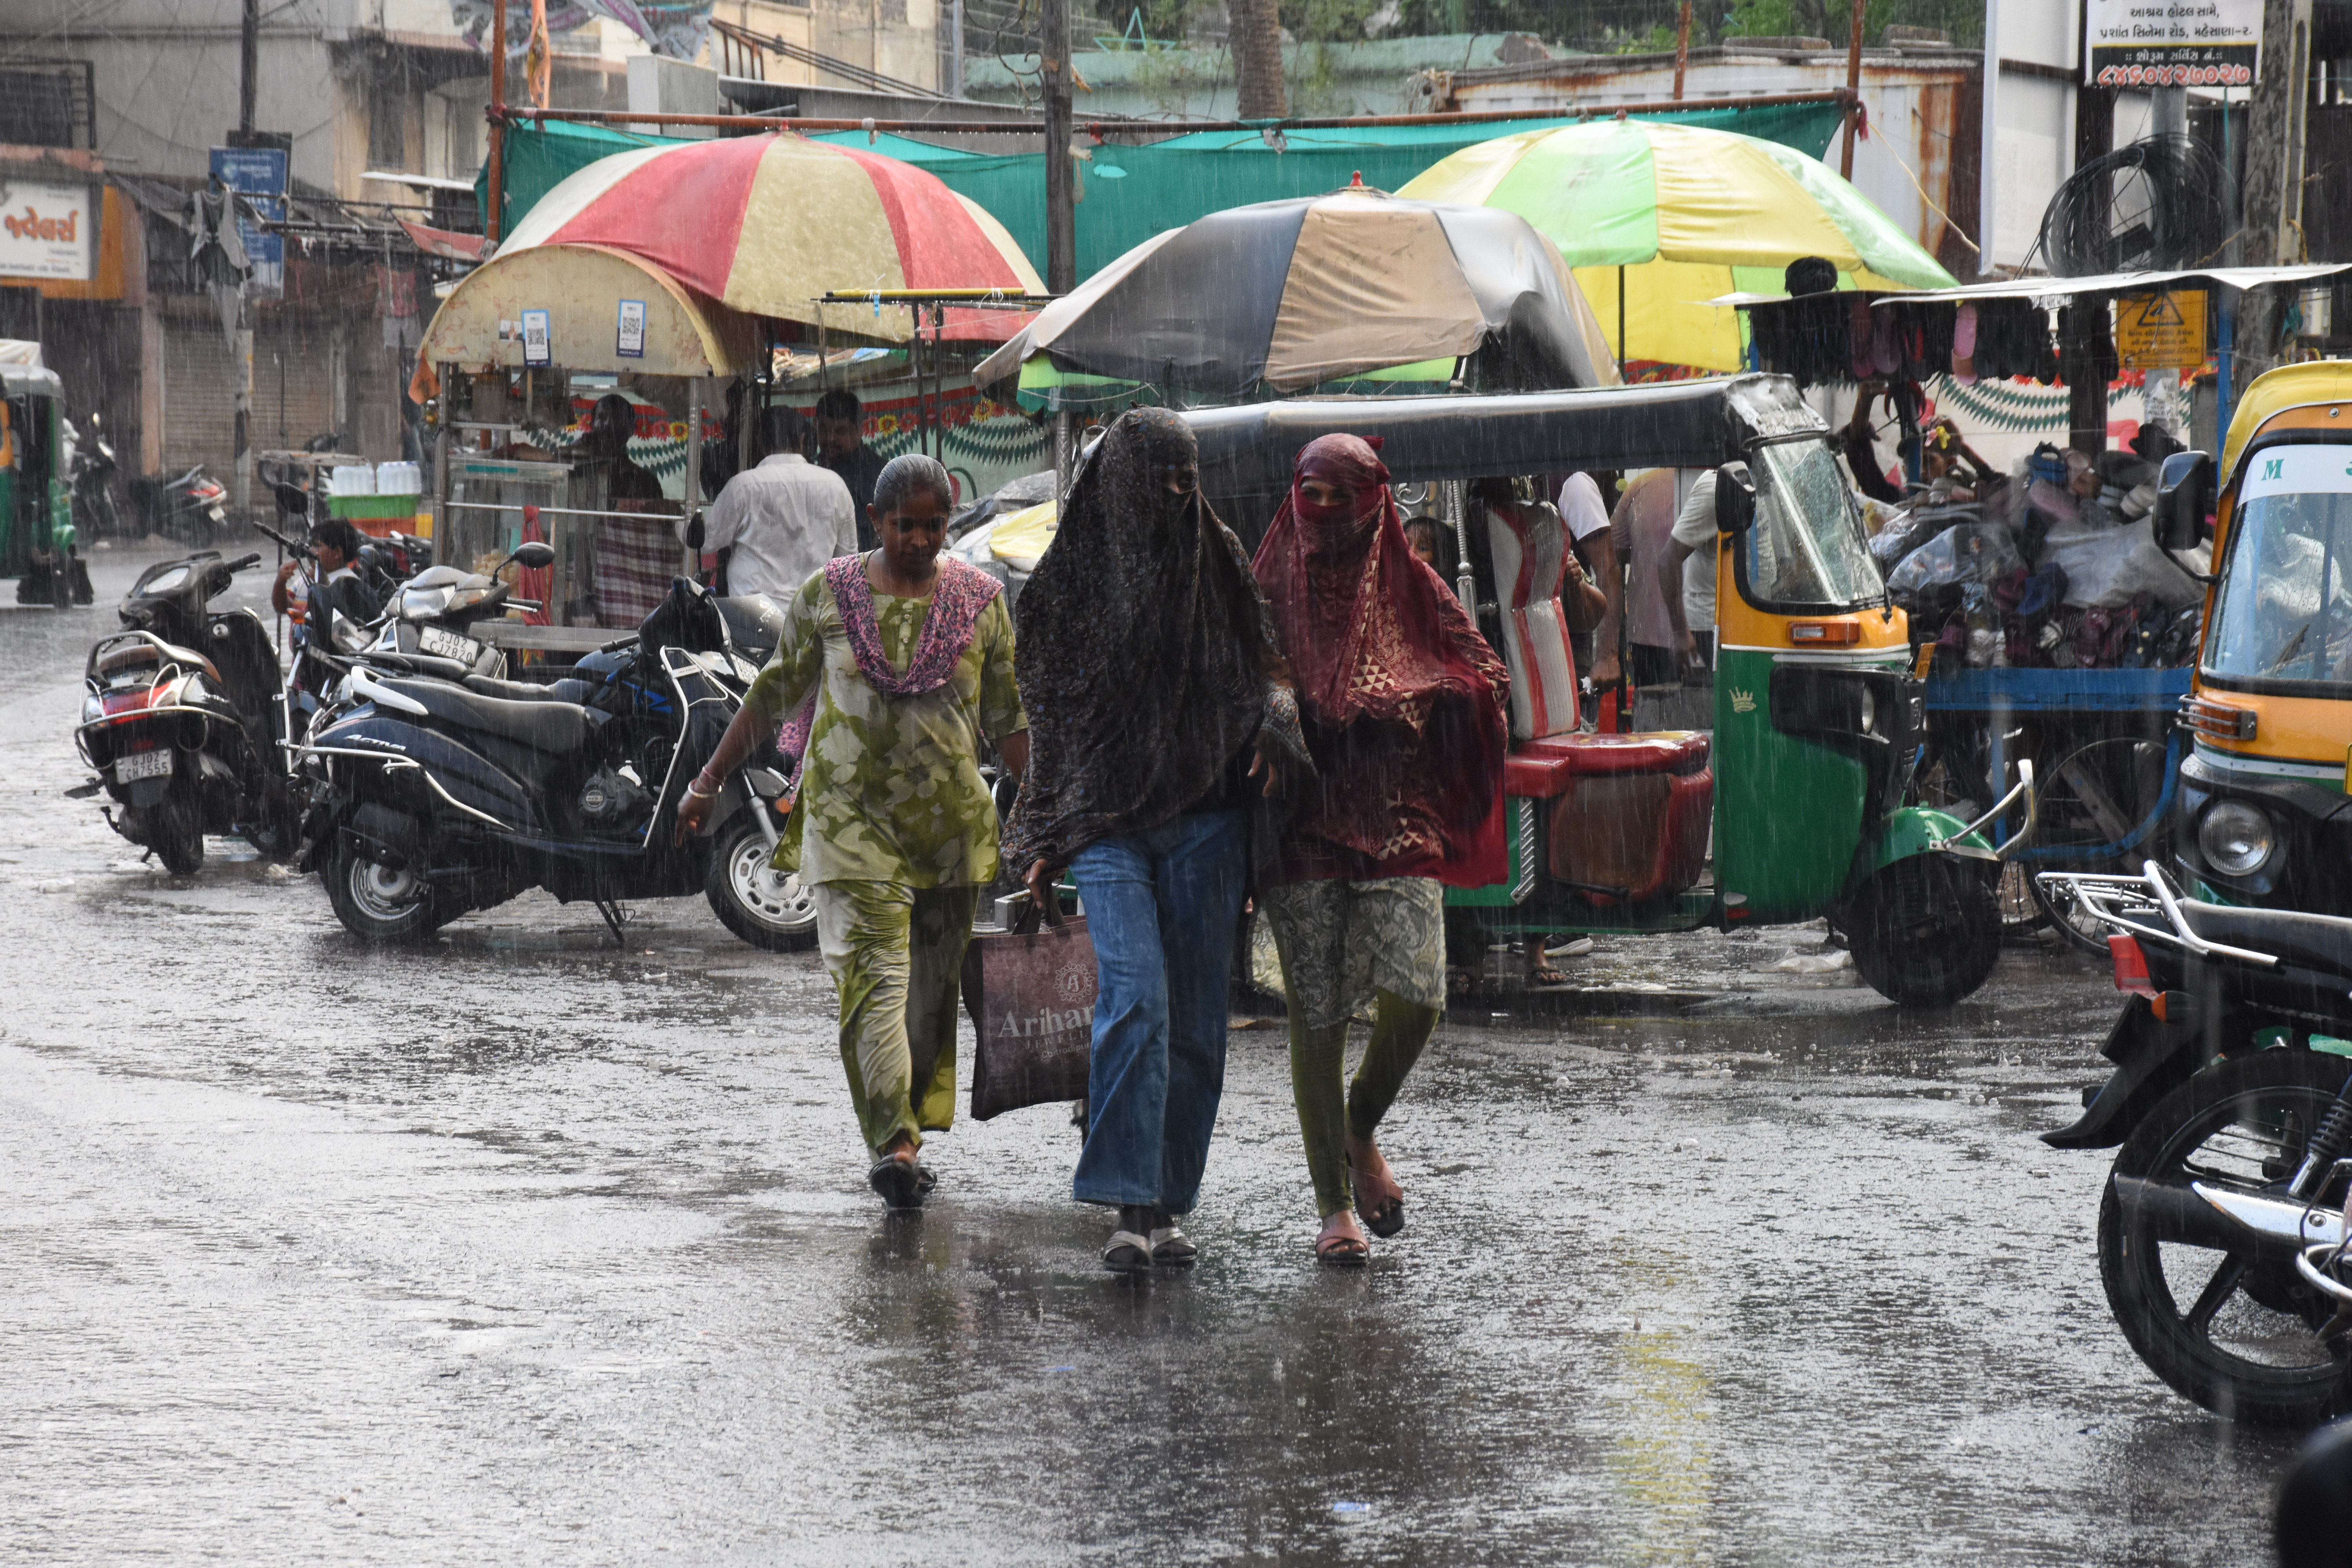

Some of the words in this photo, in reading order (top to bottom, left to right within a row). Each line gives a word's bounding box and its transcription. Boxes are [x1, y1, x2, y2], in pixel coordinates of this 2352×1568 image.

[2168, 2, 2194, 18] હોટલ
[439, 631, 467, 648] GJ02
[430, 641, 472, 662] CJ7820
[132, 752, 159, 766] GJ02
[126, 761, 168, 780] CH7555
